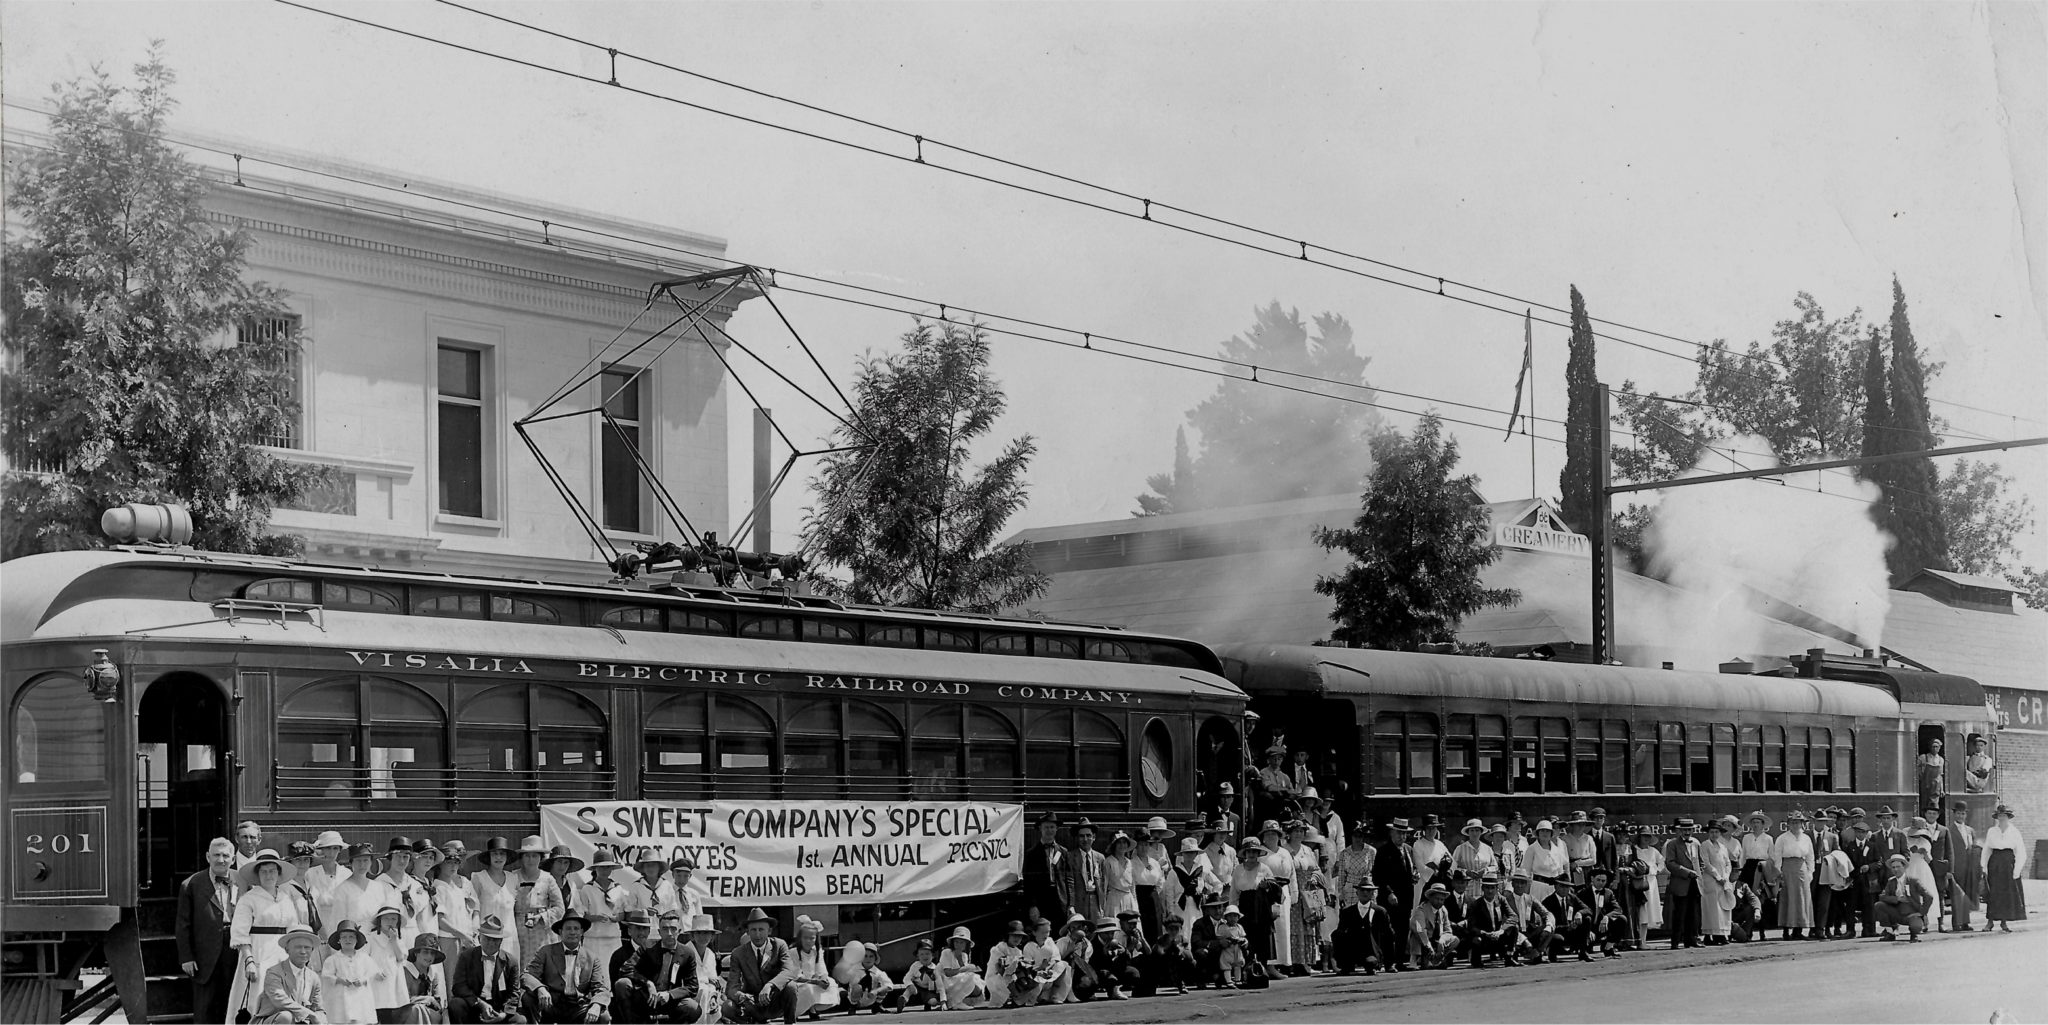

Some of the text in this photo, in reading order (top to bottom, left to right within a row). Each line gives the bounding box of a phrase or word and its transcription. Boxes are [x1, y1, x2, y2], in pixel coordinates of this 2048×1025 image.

[1503, 527, 1587, 553] CREAMERY
[345, 650, 1143, 704] VISALIA ELECTRIC RAILROAD COMPANY.
[2017, 696, 2048, 726] CR
[613, 806, 714, 838] SWEET
[728, 806, 876, 839] COMPANY'S
[26, 833, 95, 854] 201
[831, 844, 929, 868] ANNUAL
[946, 838, 1012, 864] PICNIC
[706, 873, 884, 898] TERMINUS BEACH
